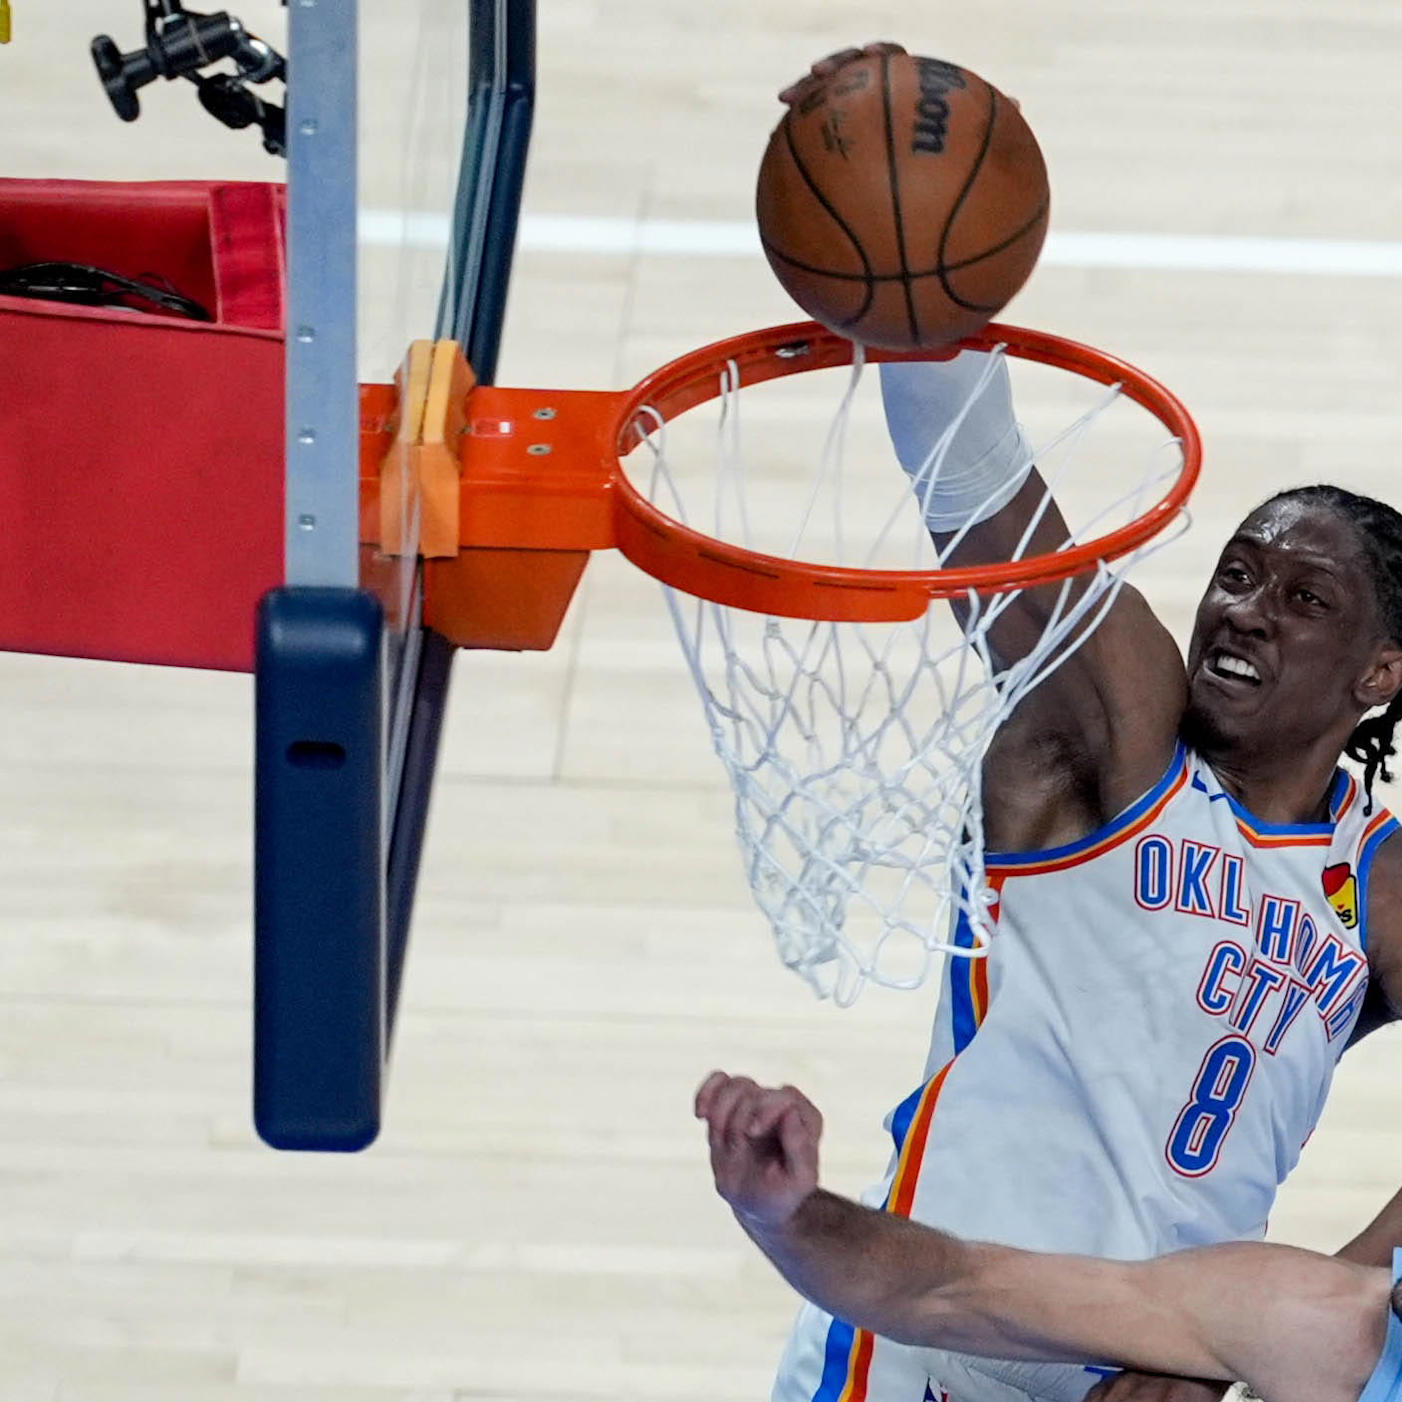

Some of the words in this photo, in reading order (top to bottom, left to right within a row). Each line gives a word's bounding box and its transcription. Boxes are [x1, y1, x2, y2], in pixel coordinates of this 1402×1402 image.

[1134, 834, 1369, 1042] OKLHOMA
[1196, 940, 1311, 1055] CTY
[1166, 1033, 1256, 1178] 8
